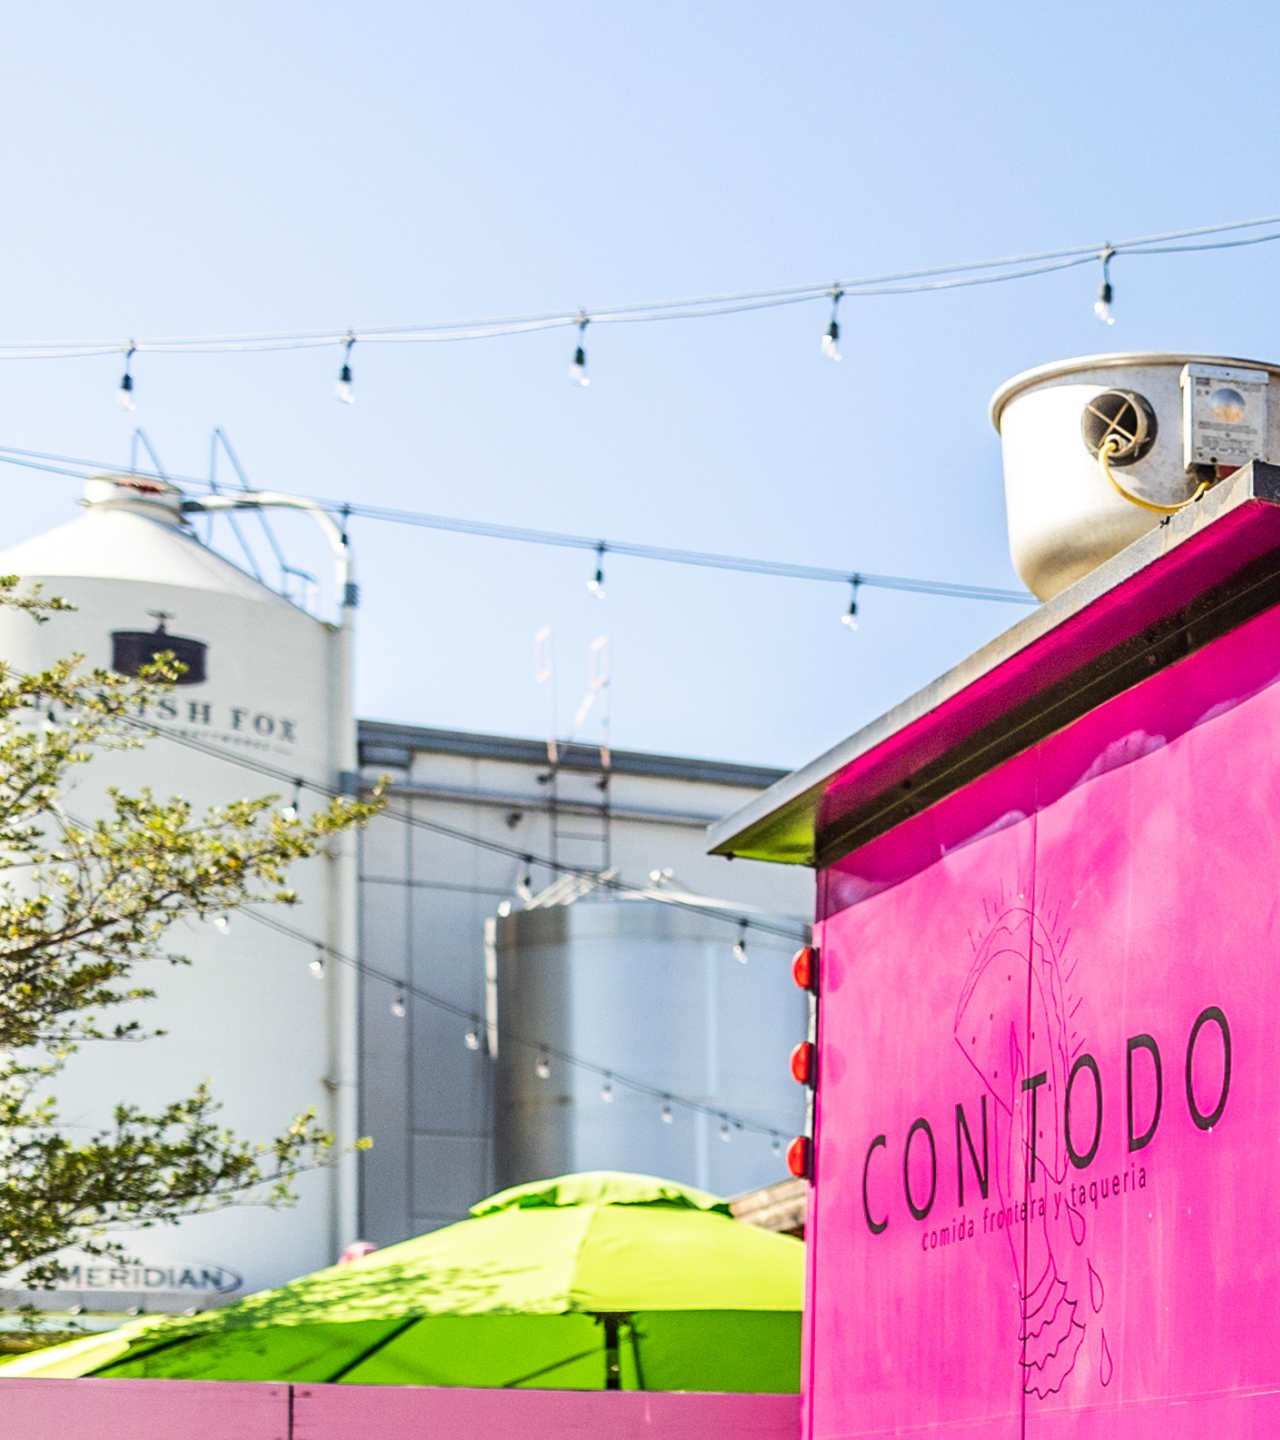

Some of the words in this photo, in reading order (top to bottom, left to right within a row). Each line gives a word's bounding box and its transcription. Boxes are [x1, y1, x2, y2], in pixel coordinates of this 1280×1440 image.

[862, 1094, 989, 1236] CON
[1021, 1005, 1232, 1184] TODO
[921, 1215, 975, 1252] comida
[983, 1196, 1045, 1234] frontera
[1053, 1191, 1062, 1220] y
[1071, 1162, 1147, 1210] taqueria
